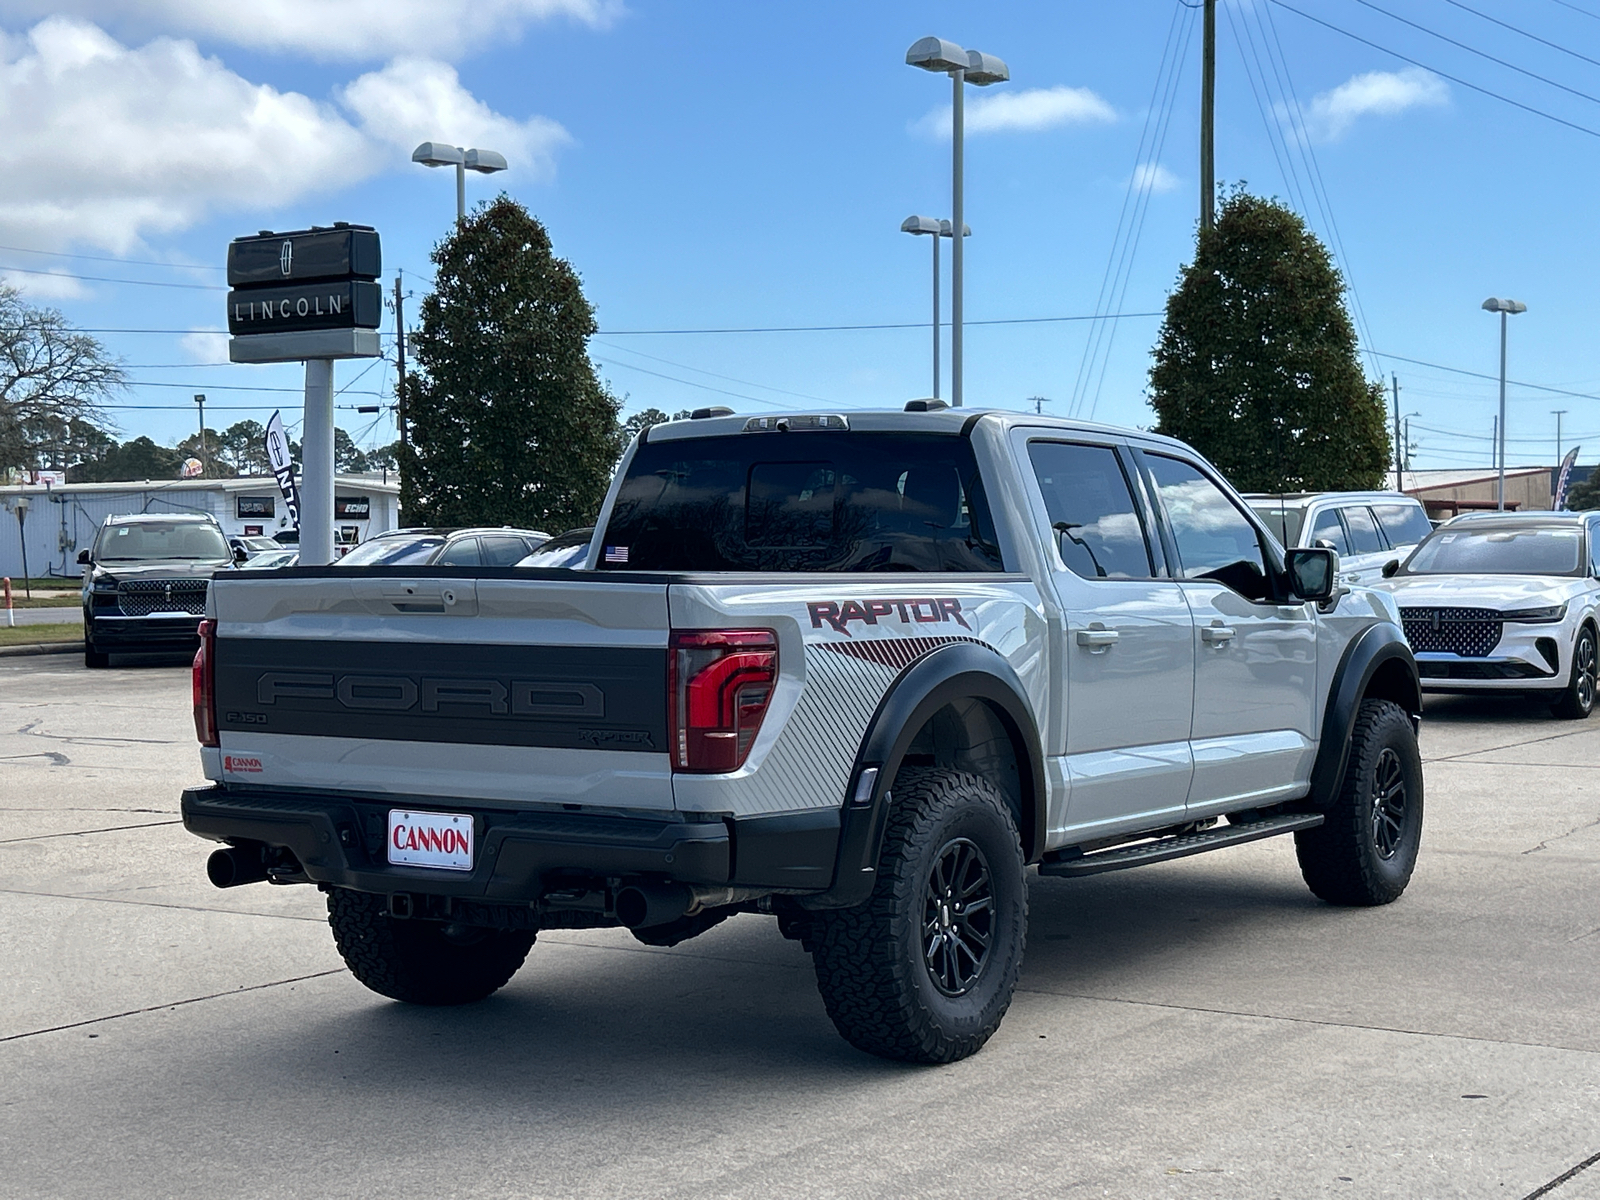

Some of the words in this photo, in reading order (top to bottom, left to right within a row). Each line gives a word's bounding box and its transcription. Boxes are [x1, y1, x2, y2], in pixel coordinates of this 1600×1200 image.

[234, 293, 343, 323] LINCOLN
[806, 597, 973, 638] RAPTOR
[256, 671, 606, 719] FORD
[577, 727, 656, 748] RAPTOR
[232, 757, 262, 767] CANNON
[392, 824, 469, 855] CANNON
